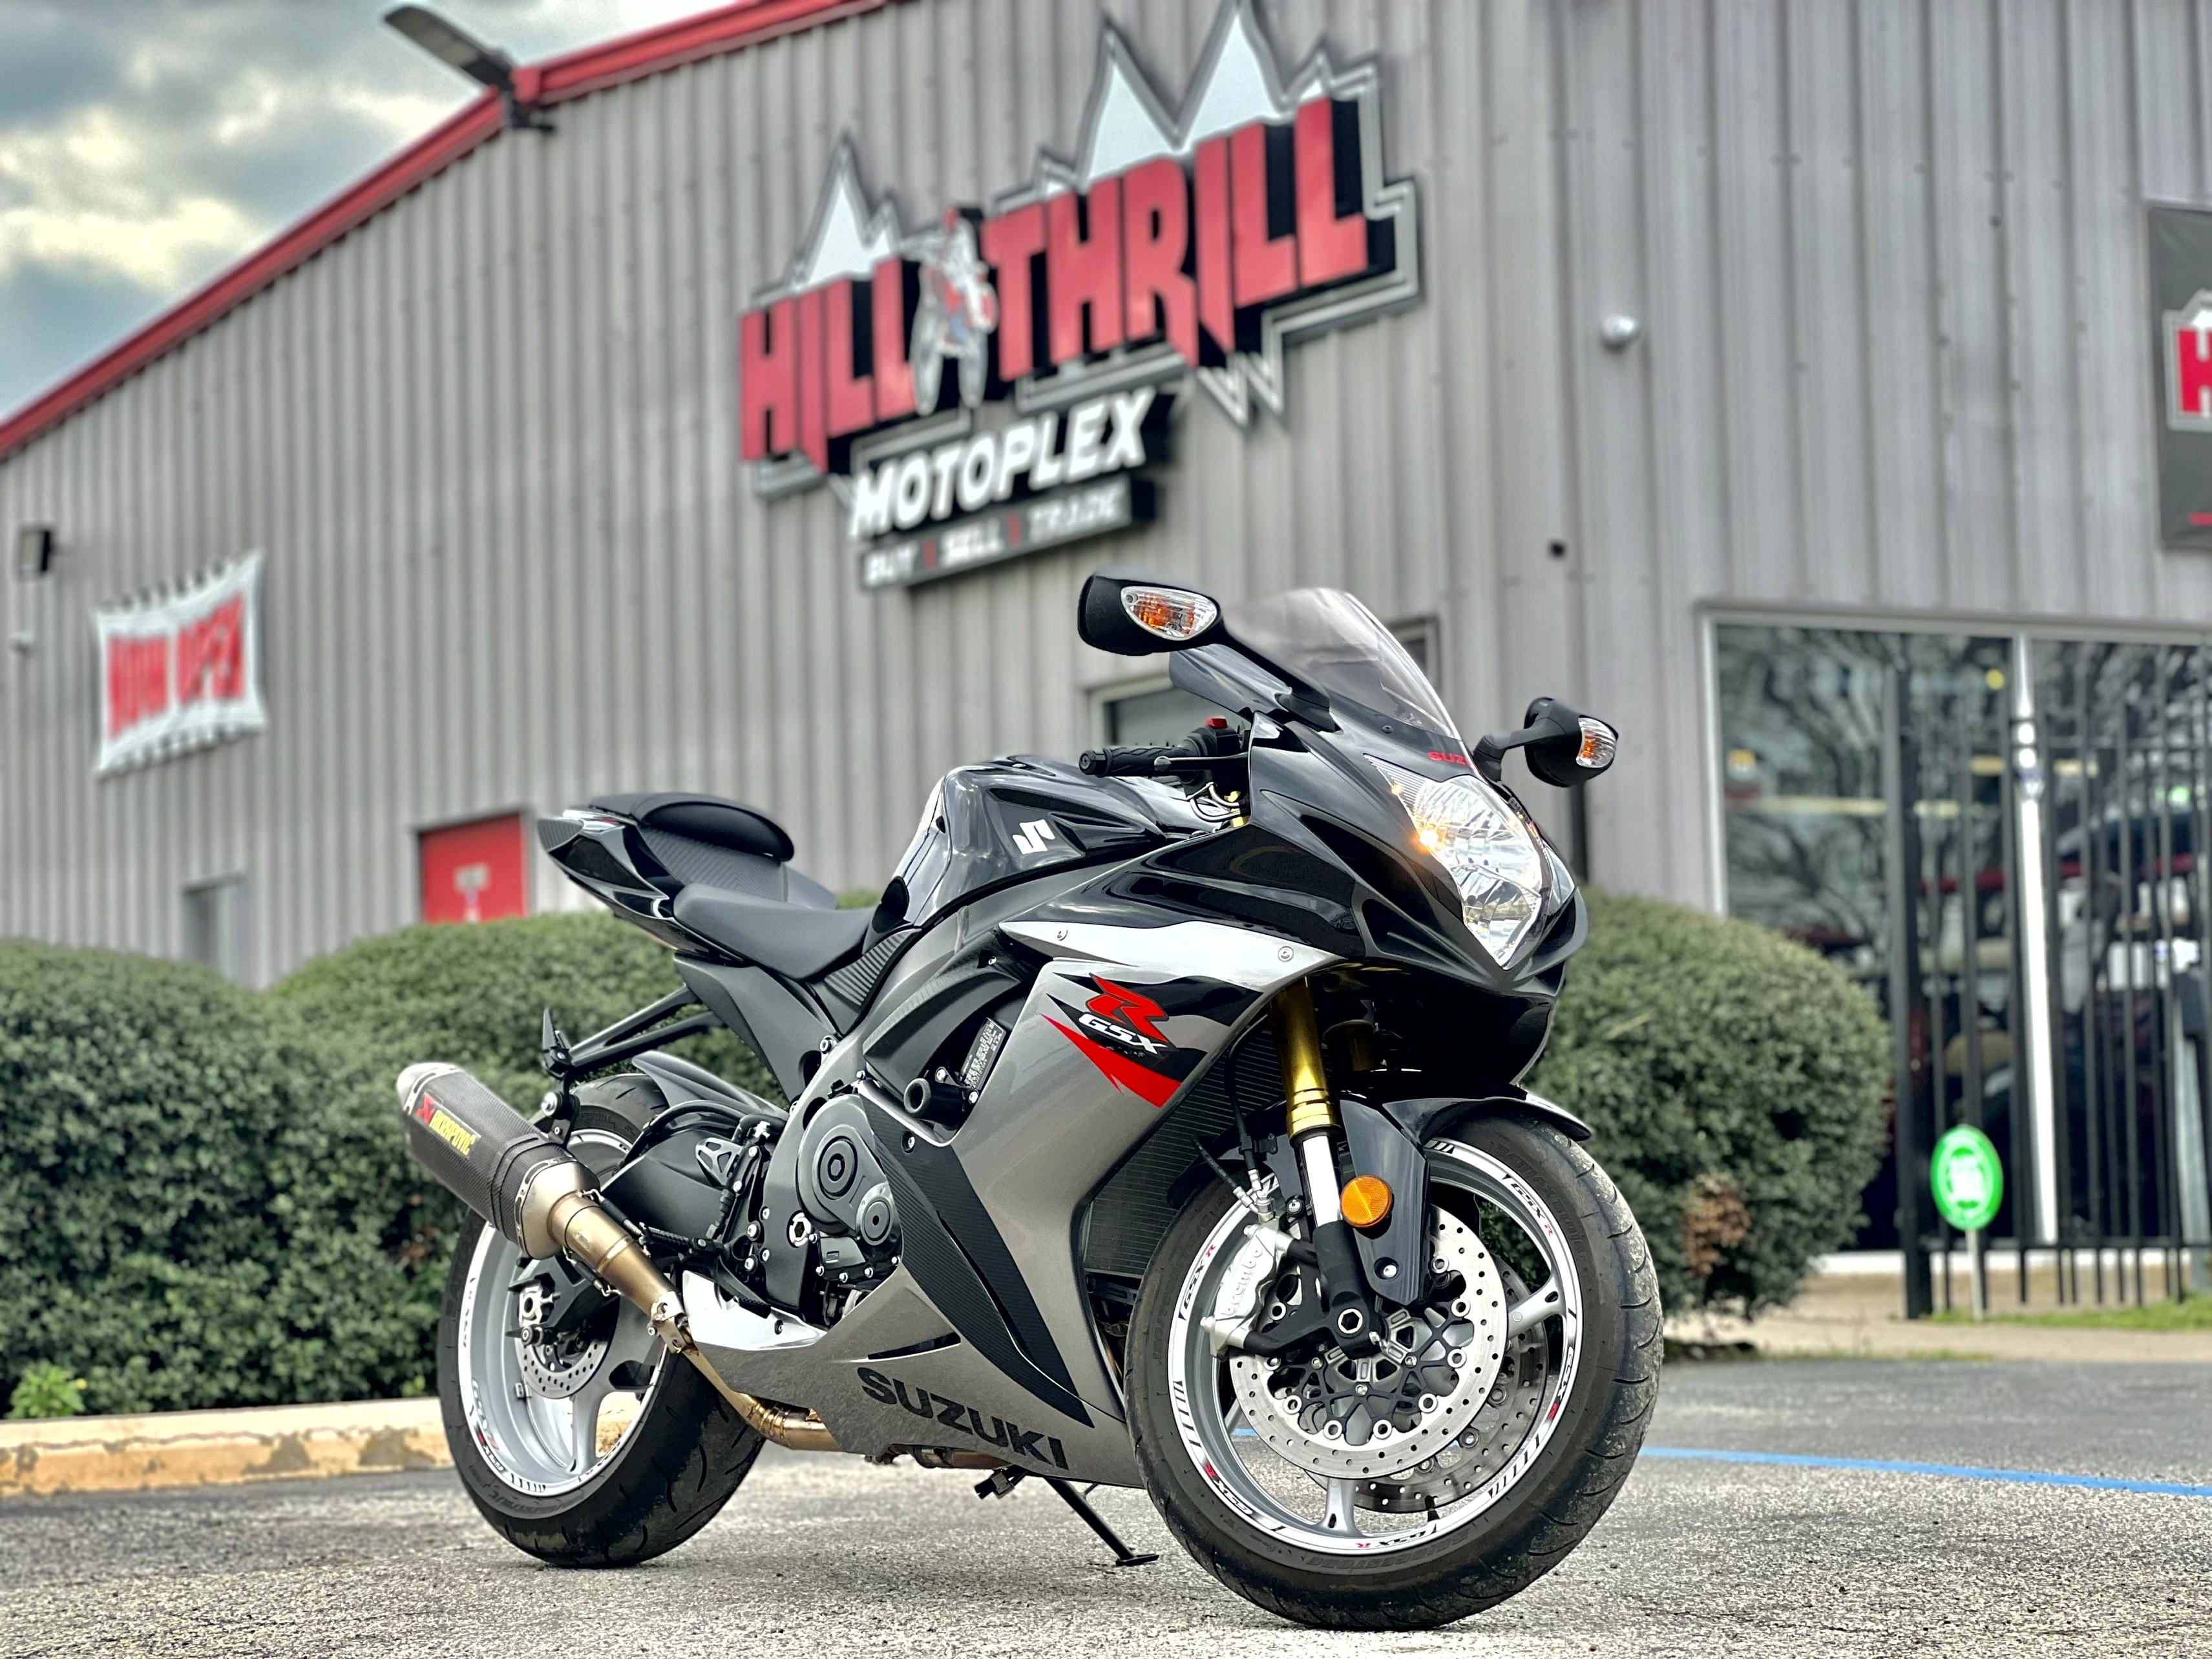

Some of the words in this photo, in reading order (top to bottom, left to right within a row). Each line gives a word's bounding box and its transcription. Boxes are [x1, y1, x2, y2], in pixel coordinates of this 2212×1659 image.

[739, 256, 918, 475] HILL
[981, 96, 1368, 382] THRILL
[849, 386, 1155, 540] MOTOPLEX
[1427, 751, 1471, 767] SUZ
[1078, 1012, 1168, 1056] GSX
[1220, 1248, 1263, 1316] brembo
[856, 1366, 1069, 1471] SUZUKI
